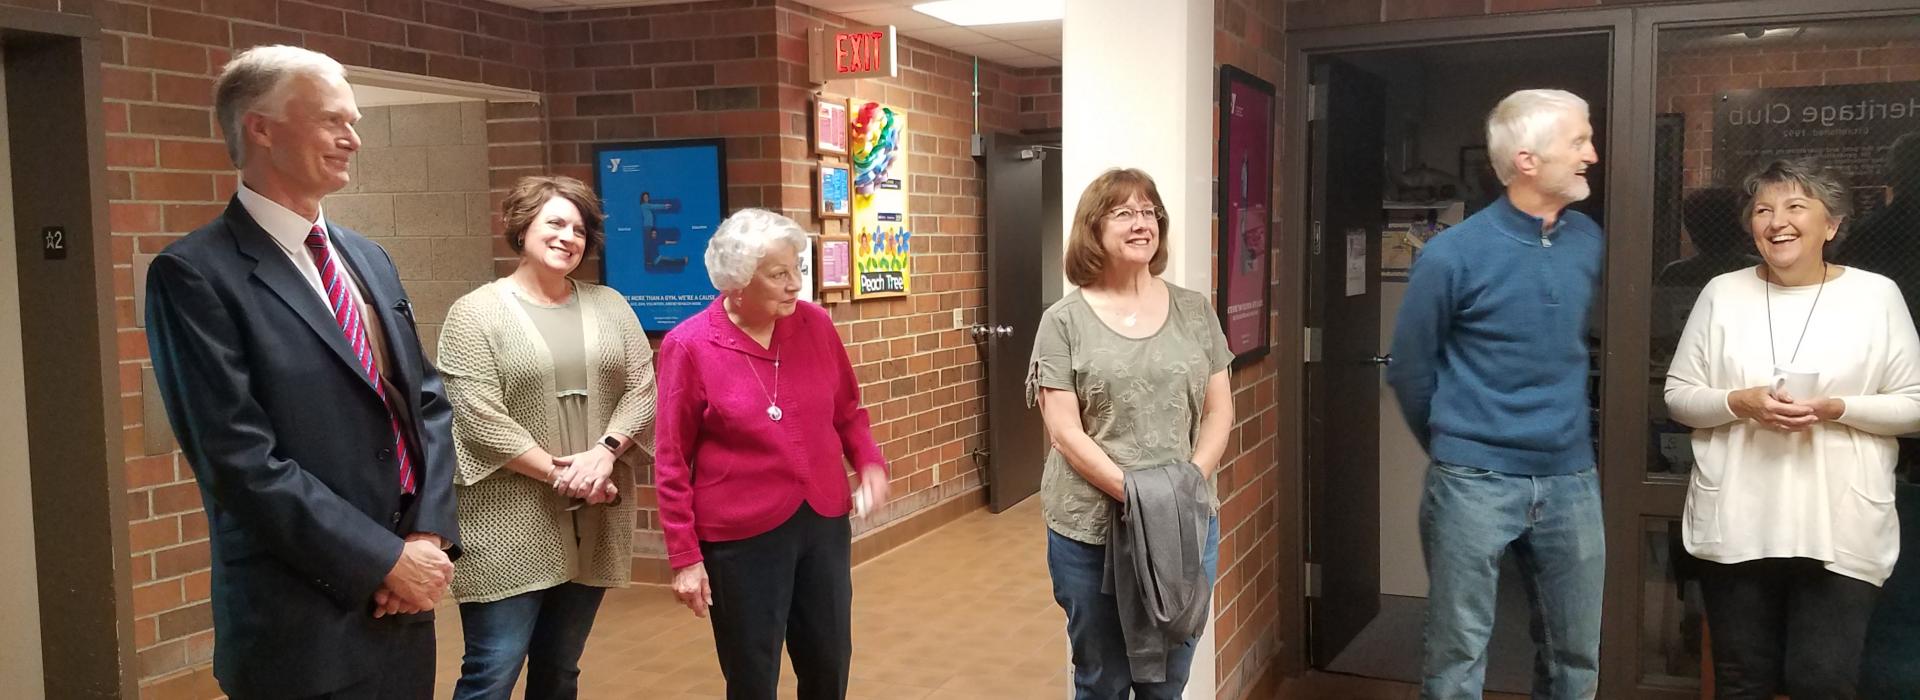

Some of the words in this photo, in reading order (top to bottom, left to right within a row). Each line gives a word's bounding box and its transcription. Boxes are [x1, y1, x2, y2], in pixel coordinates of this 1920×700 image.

[836, 32, 883, 73] EXIT
[861, 274, 884, 293] Peach
[886, 274, 904, 290] Tree
